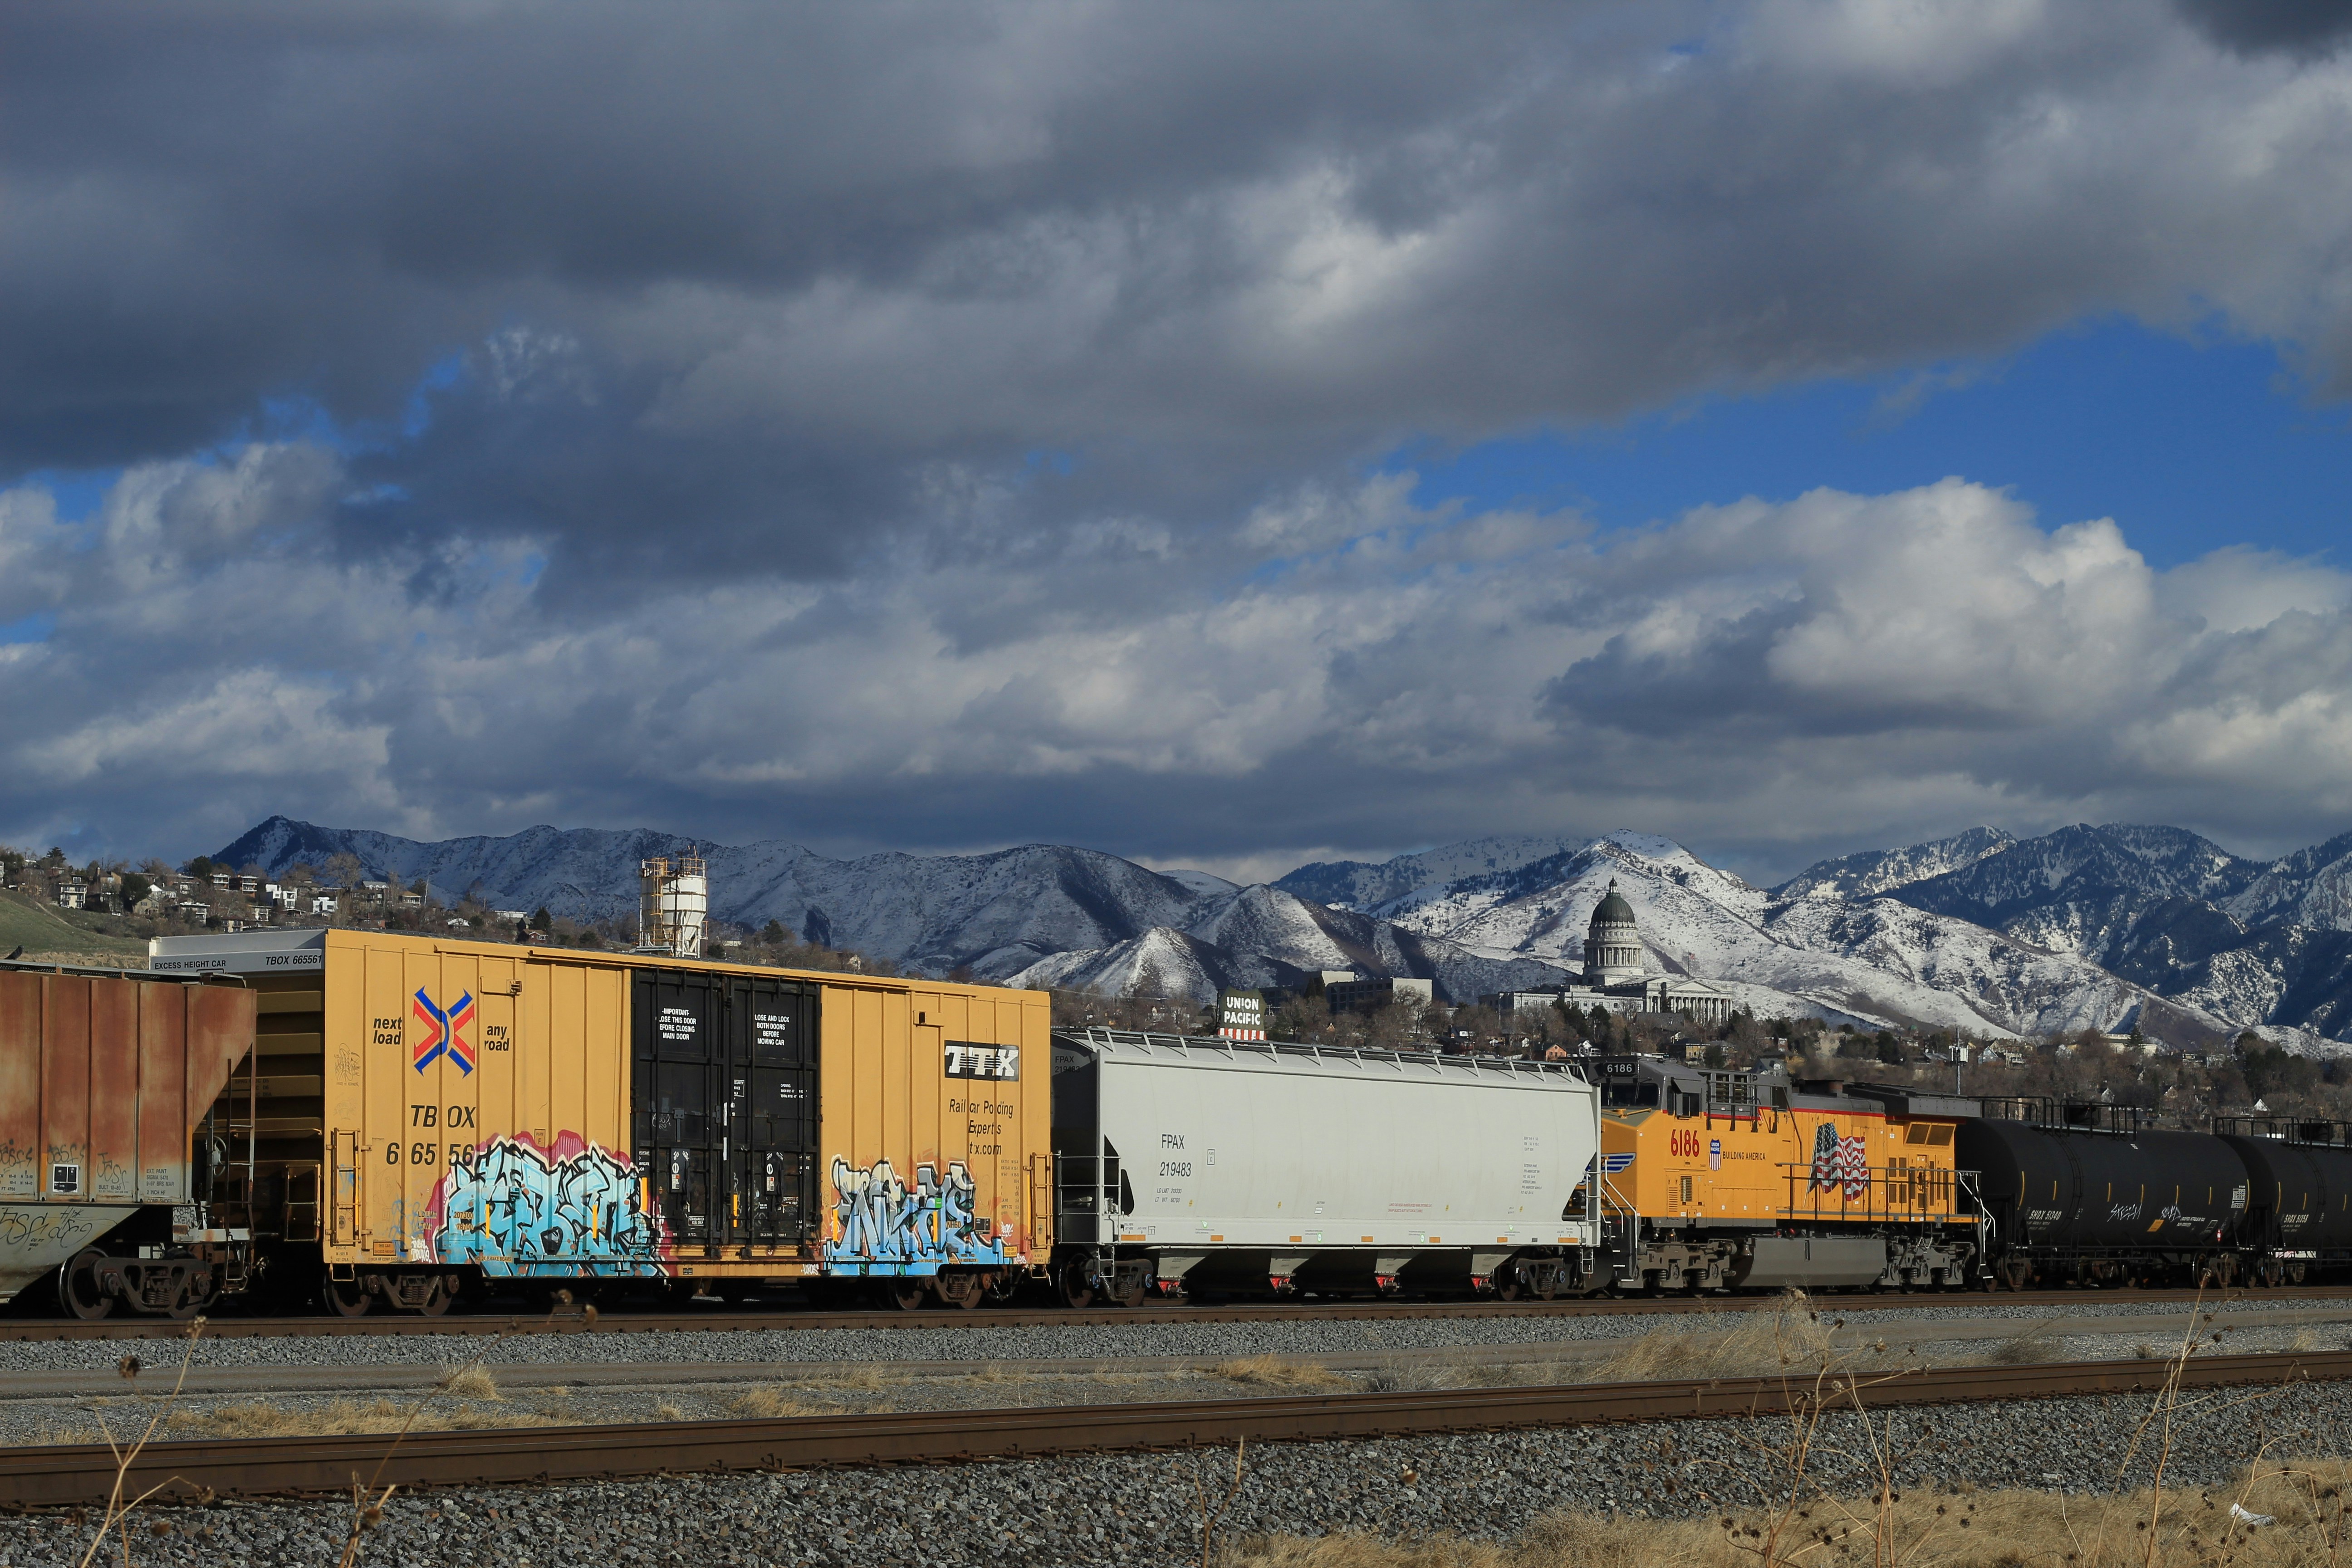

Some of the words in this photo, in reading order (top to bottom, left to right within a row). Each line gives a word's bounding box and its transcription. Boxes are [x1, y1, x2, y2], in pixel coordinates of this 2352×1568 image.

[155, 962, 181, 970] EXCESS
[265, 956, 289, 965] TBOX
[293, 955, 322, 965] 665561
[1227, 996, 1259, 1010] UNION
[373, 1017, 402, 1029] next
[1224, 1011, 1260, 1025] PACIFIC
[373, 1030, 401, 1045] load
[487, 1025, 507, 1039] any
[484, 1038, 510, 1051] road
[944, 1045, 1019, 1077] TTX
[1607, 1064, 1632, 1072] 6186
[411, 1105, 476, 1128] TBOX
[969, 1120, 1001, 1137] Experts
[1161, 1134, 1185, 1150] FPAX
[1671, 1129, 1700, 1157] 6186
[1723, 1152, 1744, 1160] BUILDING
[1160, 1161, 1191, 1177] 219483
[2029, 1210, 2046, 1220] SHQX
[2045, 1210, 2062, 1220] 51340
